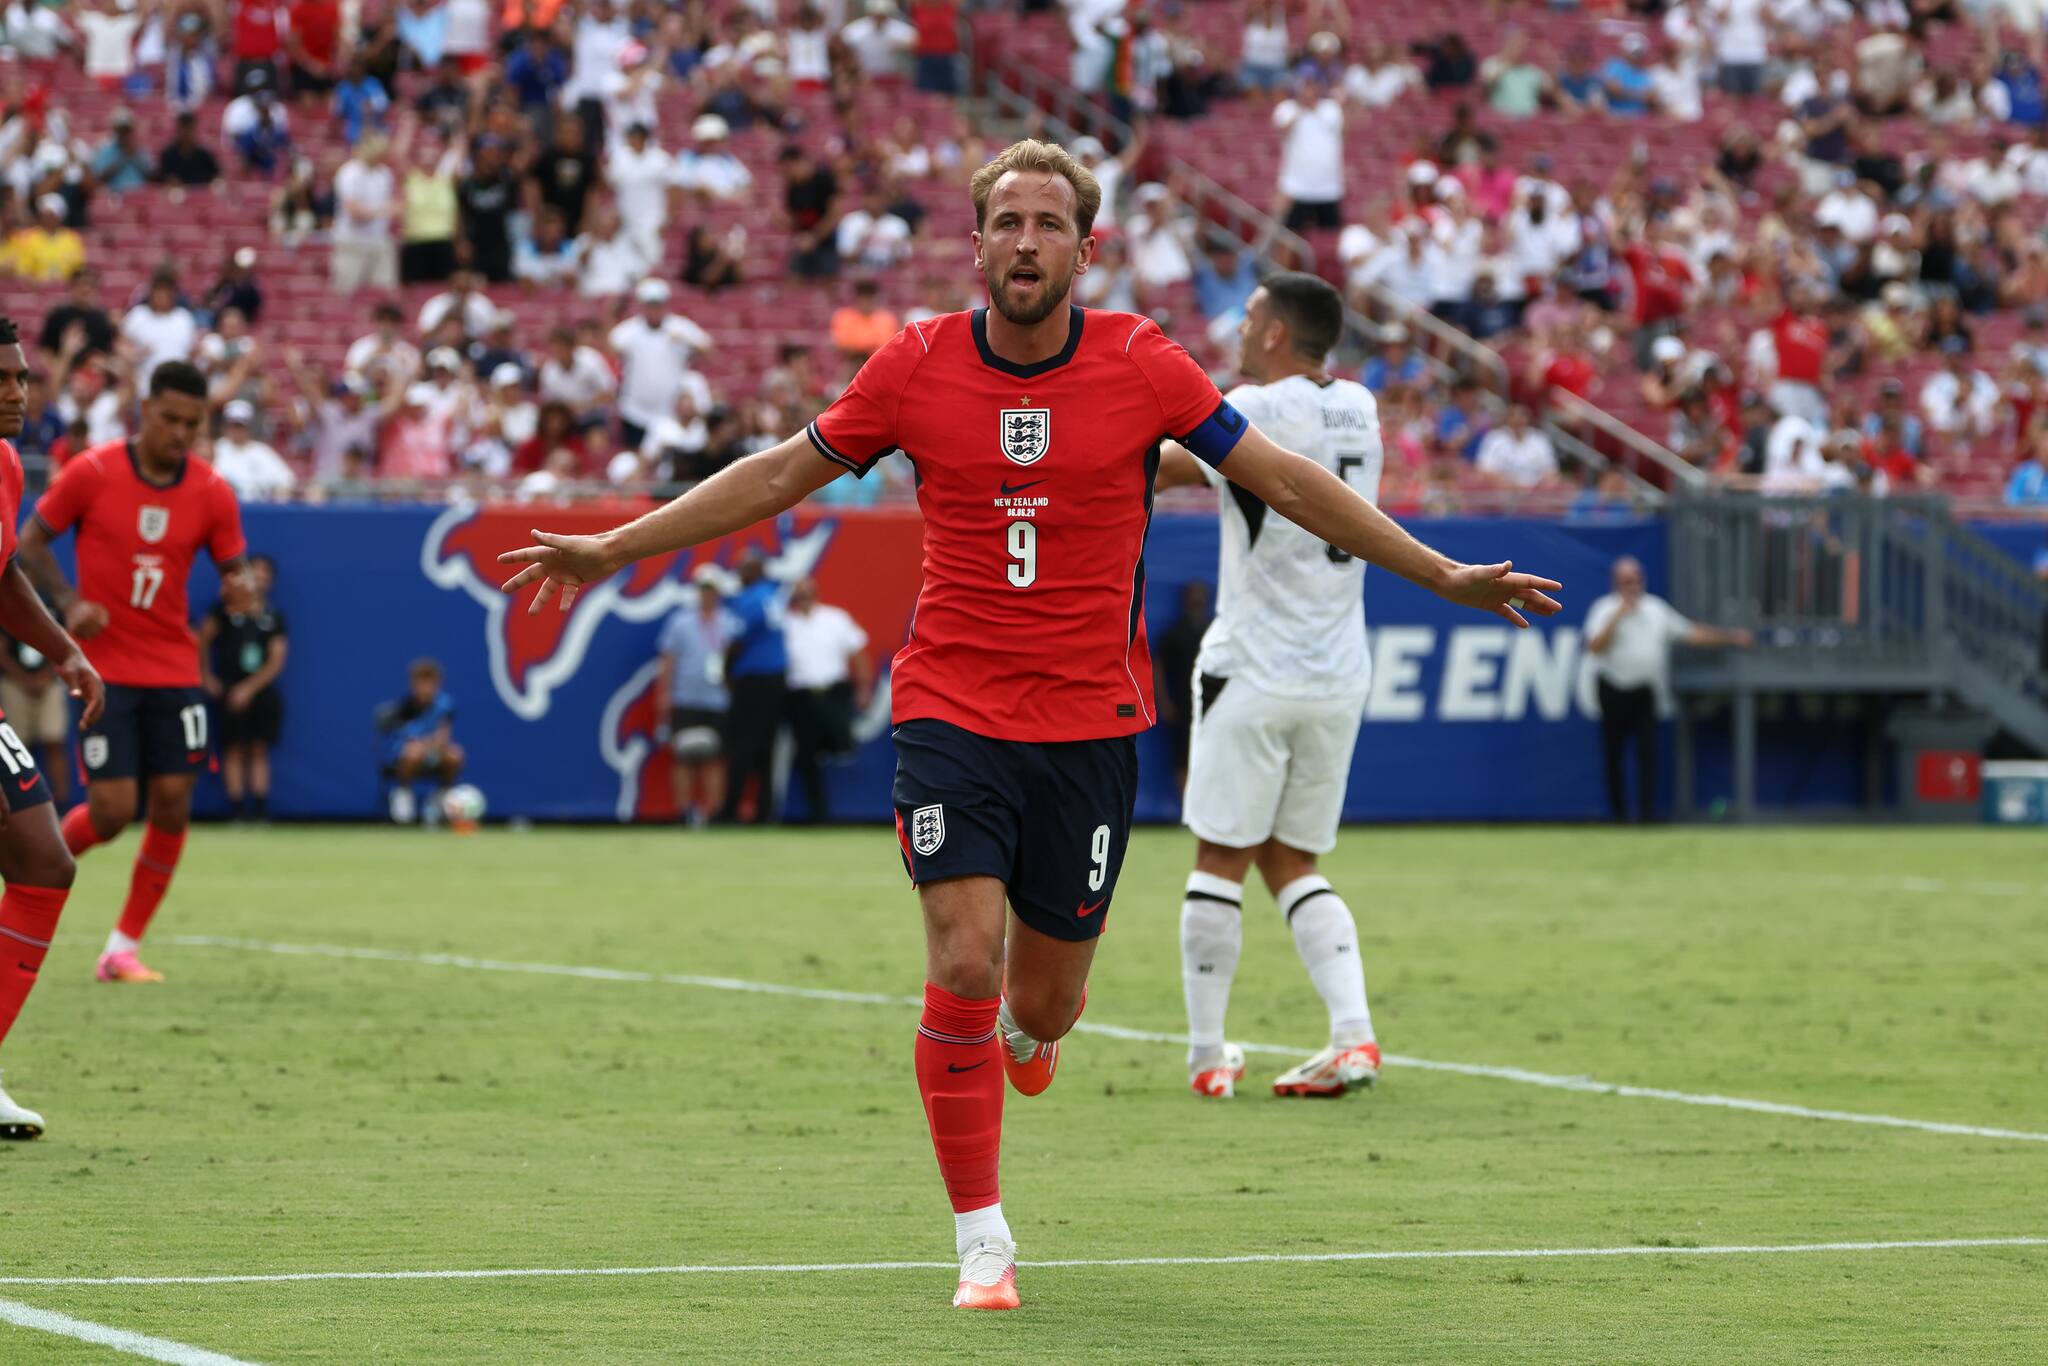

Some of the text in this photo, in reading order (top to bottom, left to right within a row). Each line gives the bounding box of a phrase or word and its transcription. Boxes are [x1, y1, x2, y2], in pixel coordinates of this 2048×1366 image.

[1212, 403, 1243, 434] C
[994, 497, 1049, 507] NEW ZEALAND
[1007, 521, 1037, 588] 9
[130, 567, 164, 610] 17
[1366, 626, 1436, 721] E
[0, 722, 35, 775] 19
[1088, 824, 1111, 892] 9
